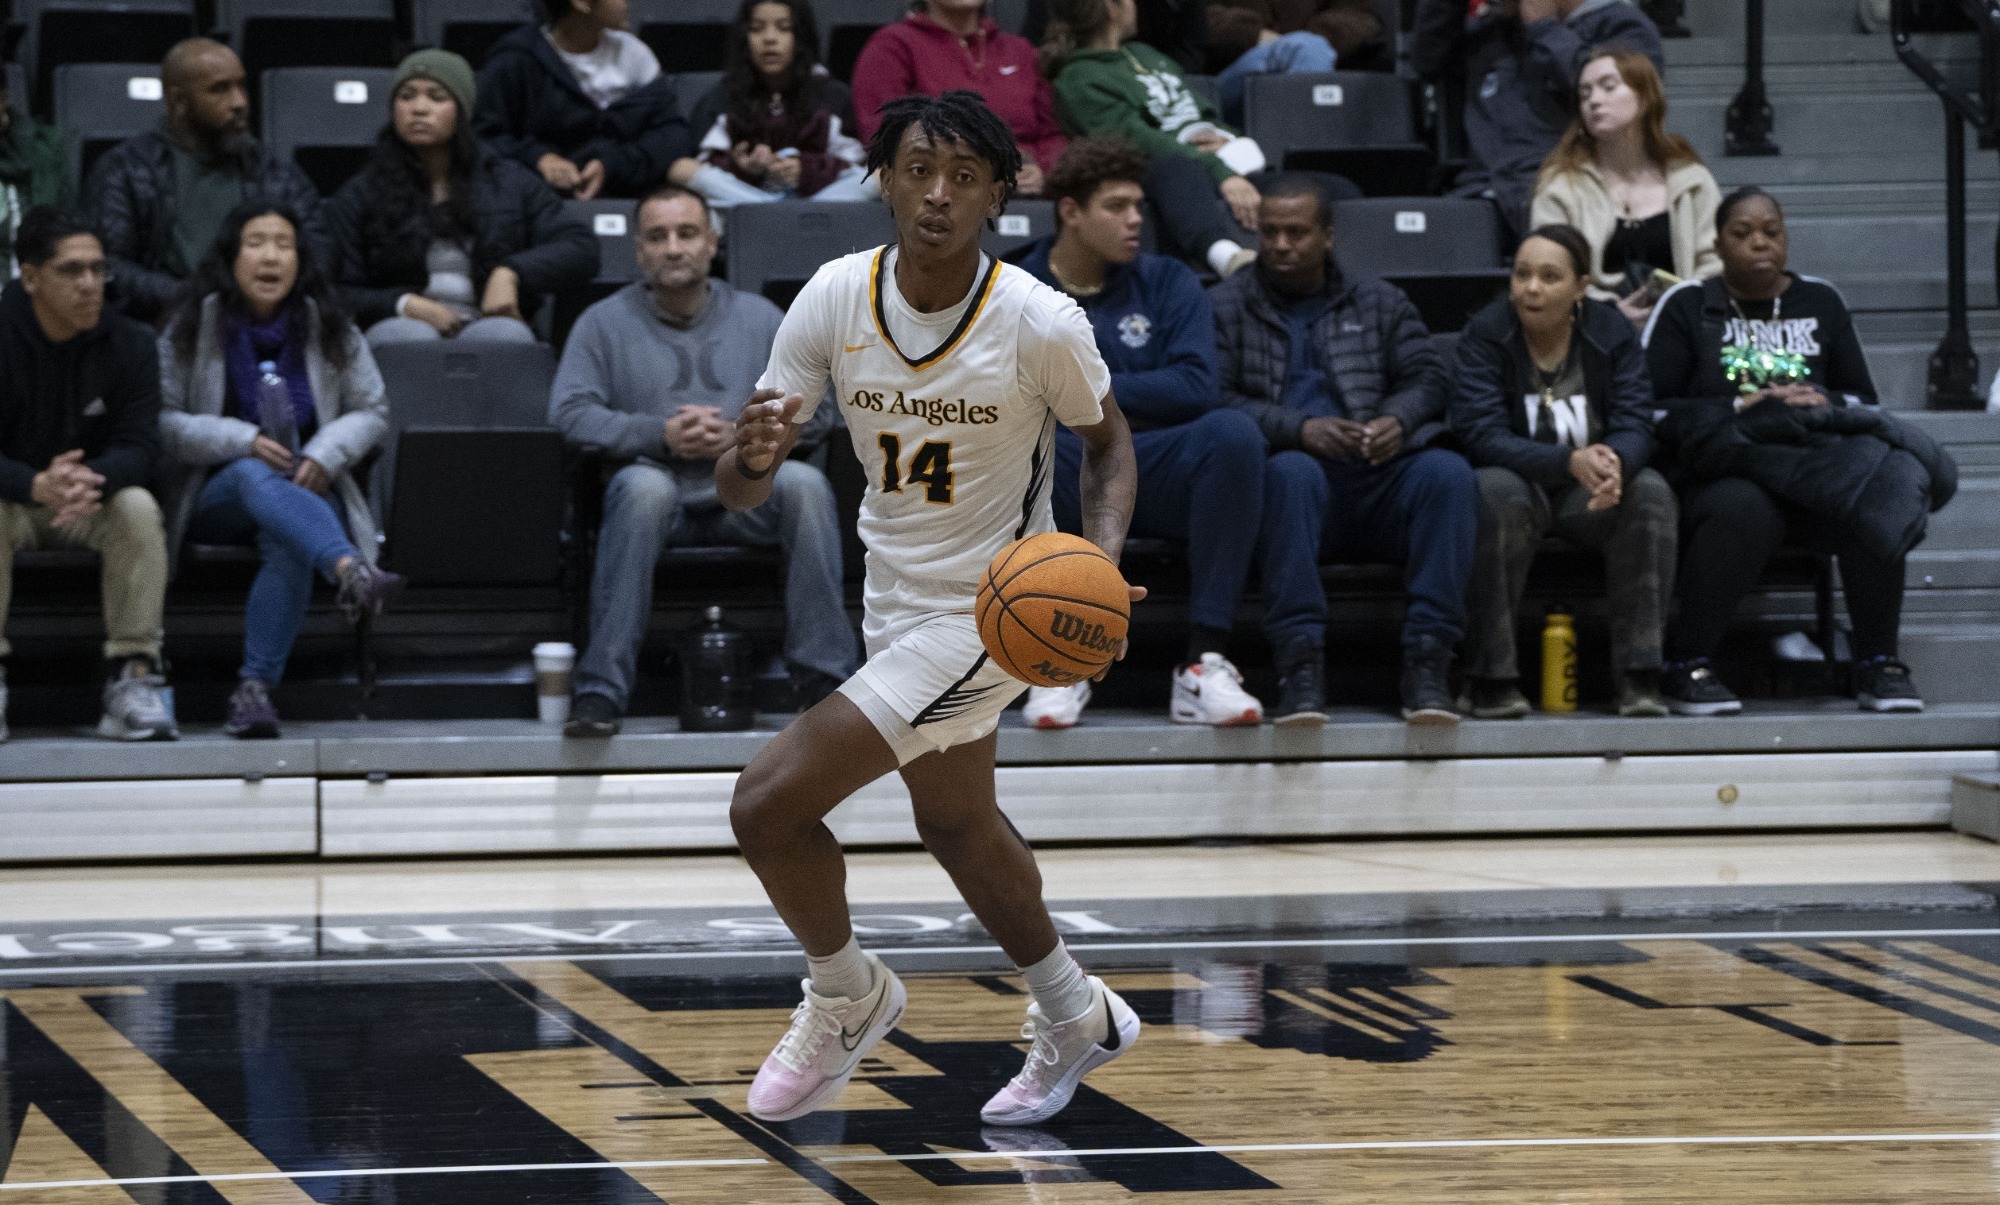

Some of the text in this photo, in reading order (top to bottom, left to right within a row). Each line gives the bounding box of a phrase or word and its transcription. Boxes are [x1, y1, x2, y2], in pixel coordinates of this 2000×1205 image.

[845, 388, 999, 426] os Angeles
[877, 431, 955, 505] 14
